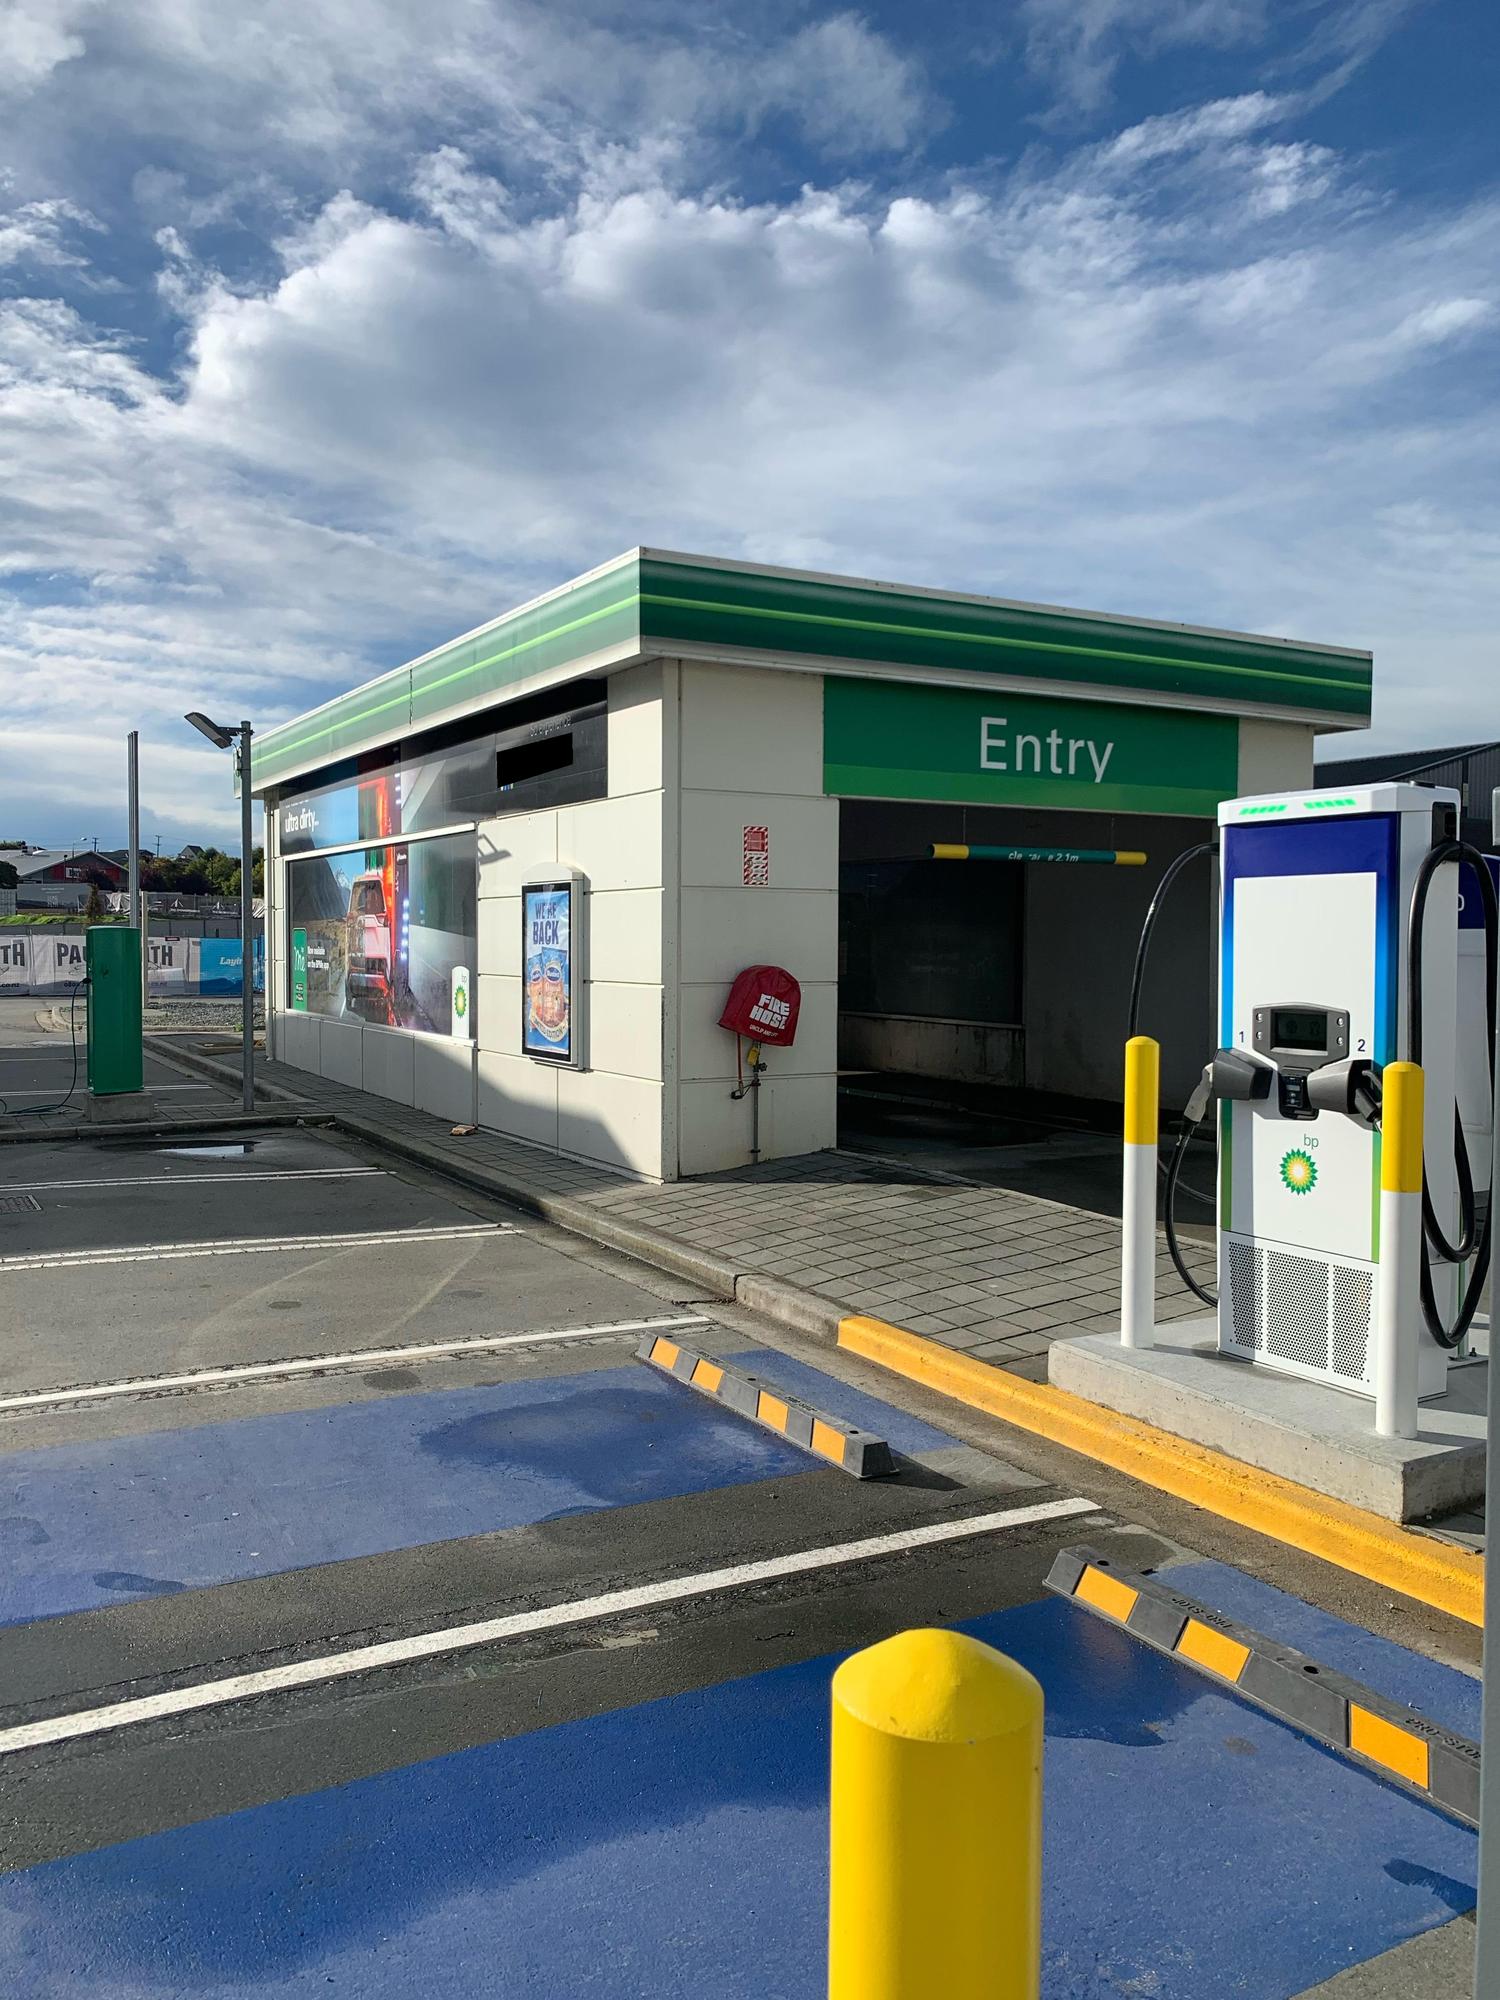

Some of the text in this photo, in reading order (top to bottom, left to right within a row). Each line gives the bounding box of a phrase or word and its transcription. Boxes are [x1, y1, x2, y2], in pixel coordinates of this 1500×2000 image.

[980, 716, 1114, 783] Entry
[285, 812, 298, 832] ultra
[532, 920, 560, 945] BACK
[57, 943, 87, 966] PA
[758, 993, 790, 1016] FIRE
[749, 1005, 788, 1030] HOSE
[1238, 1031, 1245, 1043] 1
[1357, 1039, 1366, 1052] 2
[1304, 1133, 1319, 1150] bp
